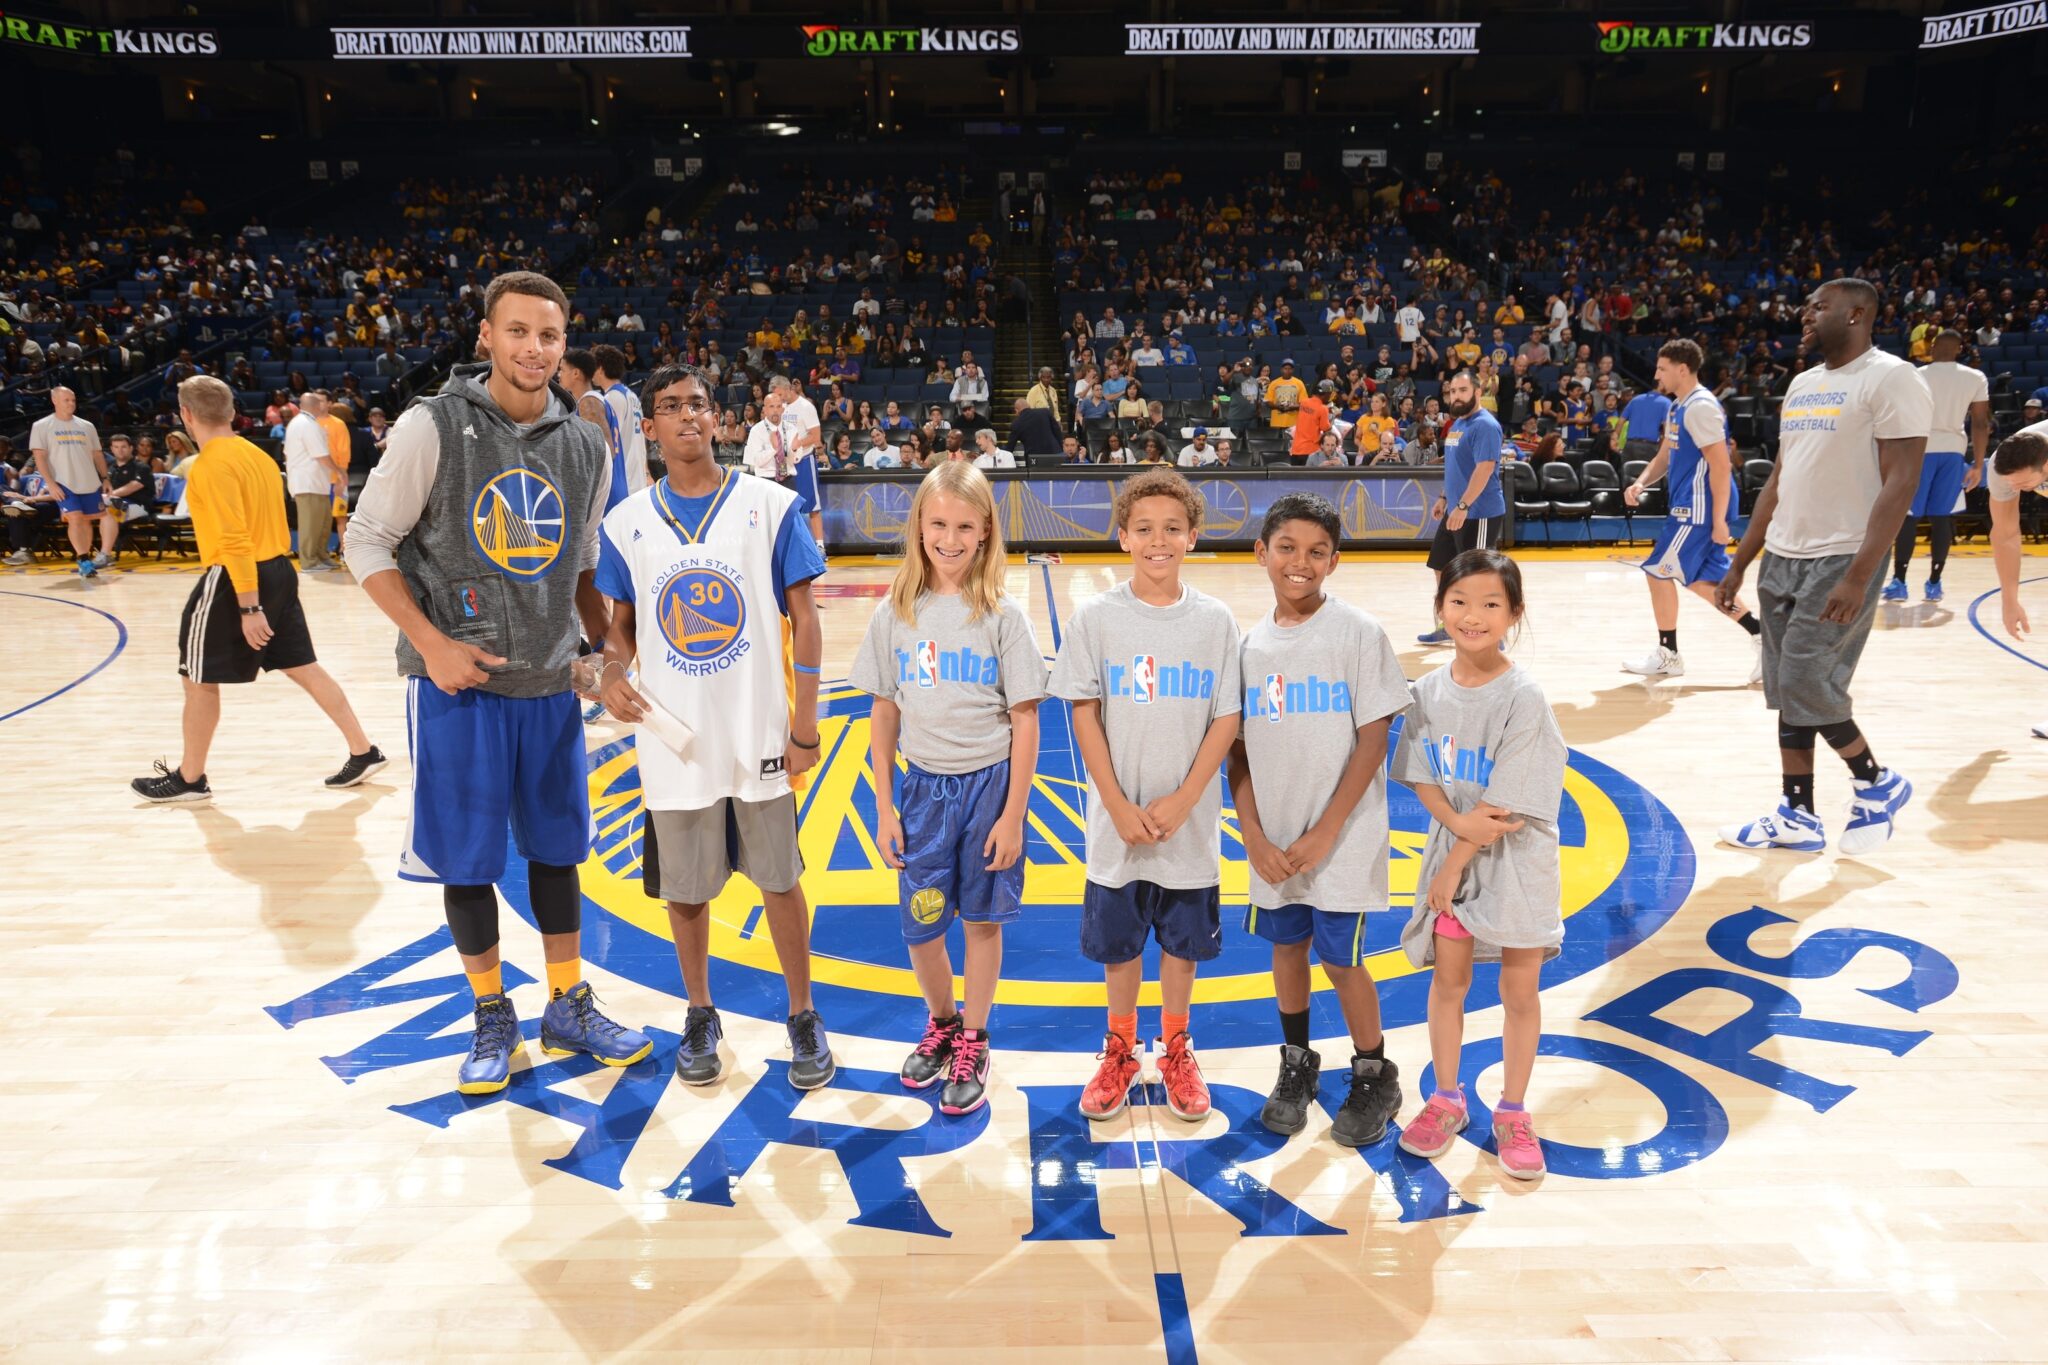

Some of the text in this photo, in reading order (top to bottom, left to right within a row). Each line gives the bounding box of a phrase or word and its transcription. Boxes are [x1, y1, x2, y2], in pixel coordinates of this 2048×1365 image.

[0, 16, 218, 54] RAFTKINGS
[805, 26, 1019, 56] DRAFTKINGS
[1129, 28, 1476, 50] DRAFT TODAY AND WIN AT DRAFTKINGS.COM
[1598, 22, 1812, 53] DRAFTKINGS
[1924, 2, 2047, 43] DRAFT TODA
[335, 31, 688, 54] DRAFT TODAY AND WIN AT DRAFTKINGS.COM
[1788, 392, 1848, 408] WARRIORS
[651, 558, 745, 595] GOLDEN STATE
[689, 581, 725, 606] 30
[665, 638, 751, 677] WARRIORS
[940, 647, 998, 686] nba
[1158, 661, 1215, 699] nba
[1286, 675, 1351, 714] nba
[1454, 746, 1494, 788] nb
[262, 905, 1960, 1241] WARRIORS
